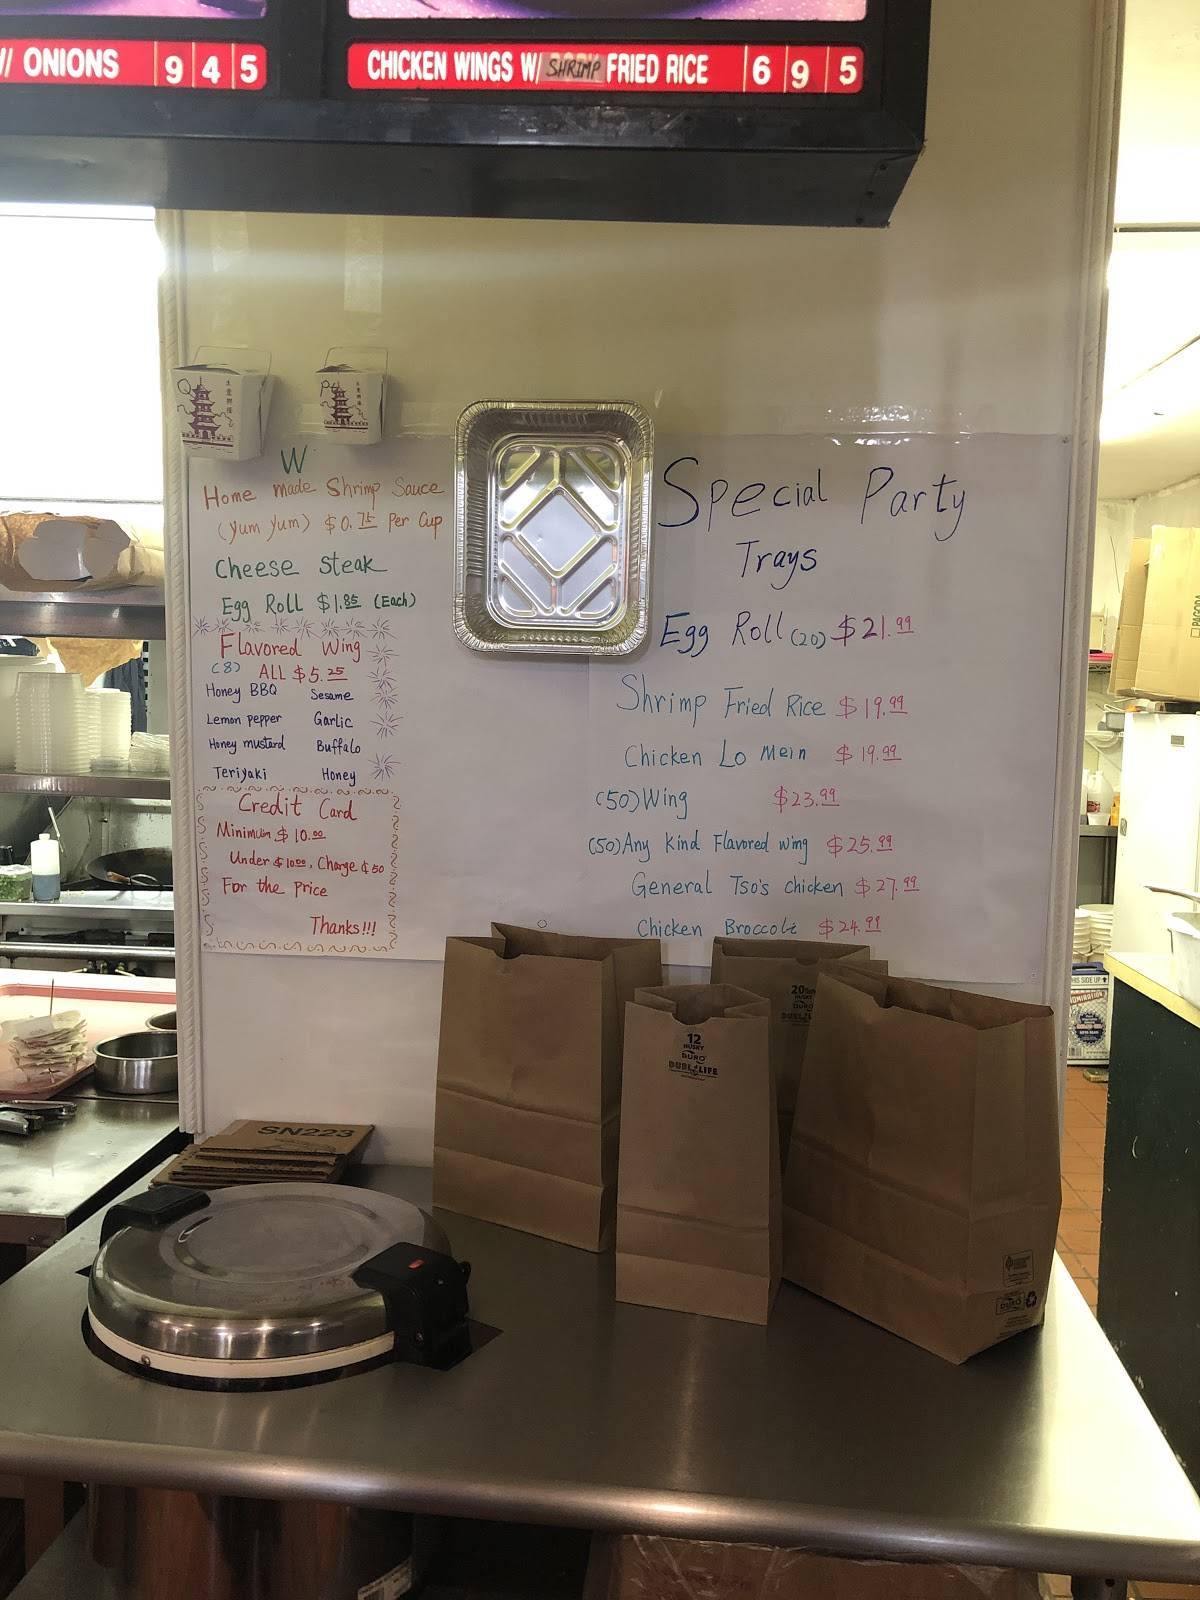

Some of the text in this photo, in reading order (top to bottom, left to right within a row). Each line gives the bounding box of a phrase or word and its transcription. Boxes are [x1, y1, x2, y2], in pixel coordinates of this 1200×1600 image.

[23, 46, 119, 79] ONIONS
[367, 49, 447, 81] CHICKEN
[454, 51, 513, 82] WINGS
[520, 51, 542, 84] W/
[546, 57, 602, 80] SHRIMP
[606, 53, 660, 84] FRIED
[666, 53, 709, 84] RICE
[280, 445, 308, 474] W
[203, 485, 257, 510] Home
[326, 476, 381, 511] Shrimp
[392, 476, 445, 498] Sauce
[657, 456, 966, 542] Special Party
[418, 511, 443, 541] Cup
[735, 540, 818, 591] Trays
[222, 597, 252, 623] Egg
[266, 593, 304, 615] Roll
[373, 592, 416, 610] (Each)
[220, 632, 302, 659] Flavored
[660, 611, 710, 659] Egg
[731, 610, 784, 647] Roll
[259, 664, 286, 681] ALL
[205, 682, 278, 704] Honey BBQ
[310, 688, 354, 701] Sesame
[616, 673, 707, 728] Shrimp
[723, 685, 775, 720] Fried
[786, 693, 827, 718] Rice
[206, 713, 283, 729] Lemon pepper
[313, 711, 354, 729] Garlic
[208, 737, 237, 755] Honey
[316, 738, 361, 755] Buffalo
[624, 742, 703, 769] Chicken
[719, 738, 747, 769] Lo
[212, 766, 267, 784] Teriyaki
[322, 767, 356, 787] Honey
[238, 792, 358, 821] Credit Card
[216, 820, 271, 839] Minimum
[713, 829, 770, 853] Flavored
[229, 850, 270, 867] Under
[317, 855, 358, 877] Charge
[222, 877, 248, 896] For
[256, 875, 285, 895] the
[631, 869, 713, 898] General
[729, 874, 770, 897] Tso's
[310, 914, 377, 937] Thanks!!!
[637, 916, 703, 938] Chicken
[724, 916, 798, 936] Broccoli
[791, 985, 805, 994] 20
[687, 1033, 701, 1044] 12
[257, 1125, 355, 1138] SN223
